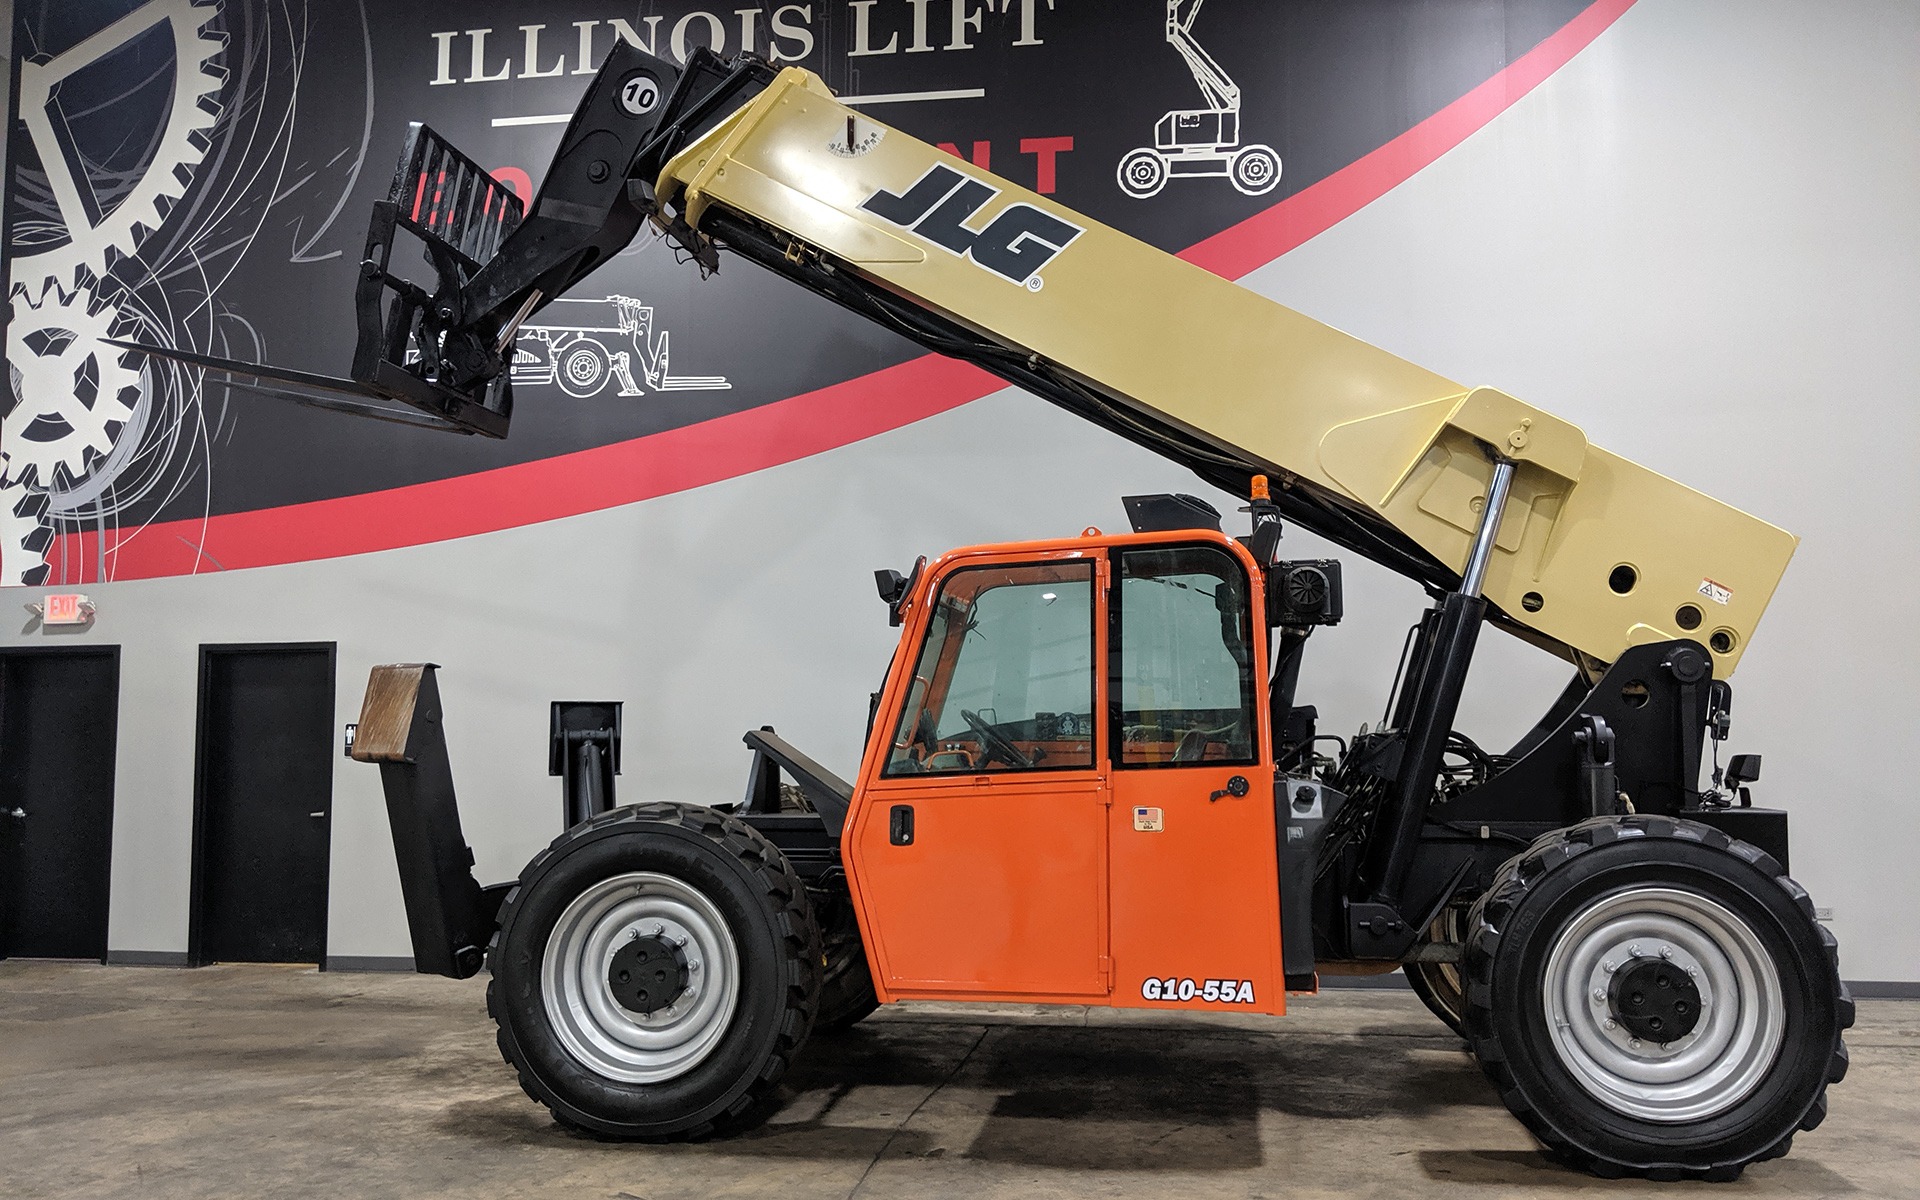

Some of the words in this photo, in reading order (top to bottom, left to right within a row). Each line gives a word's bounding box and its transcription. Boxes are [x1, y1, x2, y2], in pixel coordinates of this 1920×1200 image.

[429, 4, 814, 85] ILLINOIS
[847, 0, 1054, 56] LIFT
[626, 83, 655, 108] 10
[859, 161, 1087, 286] JLG
[50, 596, 78, 617] EXIT
[1142, 977, 1256, 1004] G10-55A
